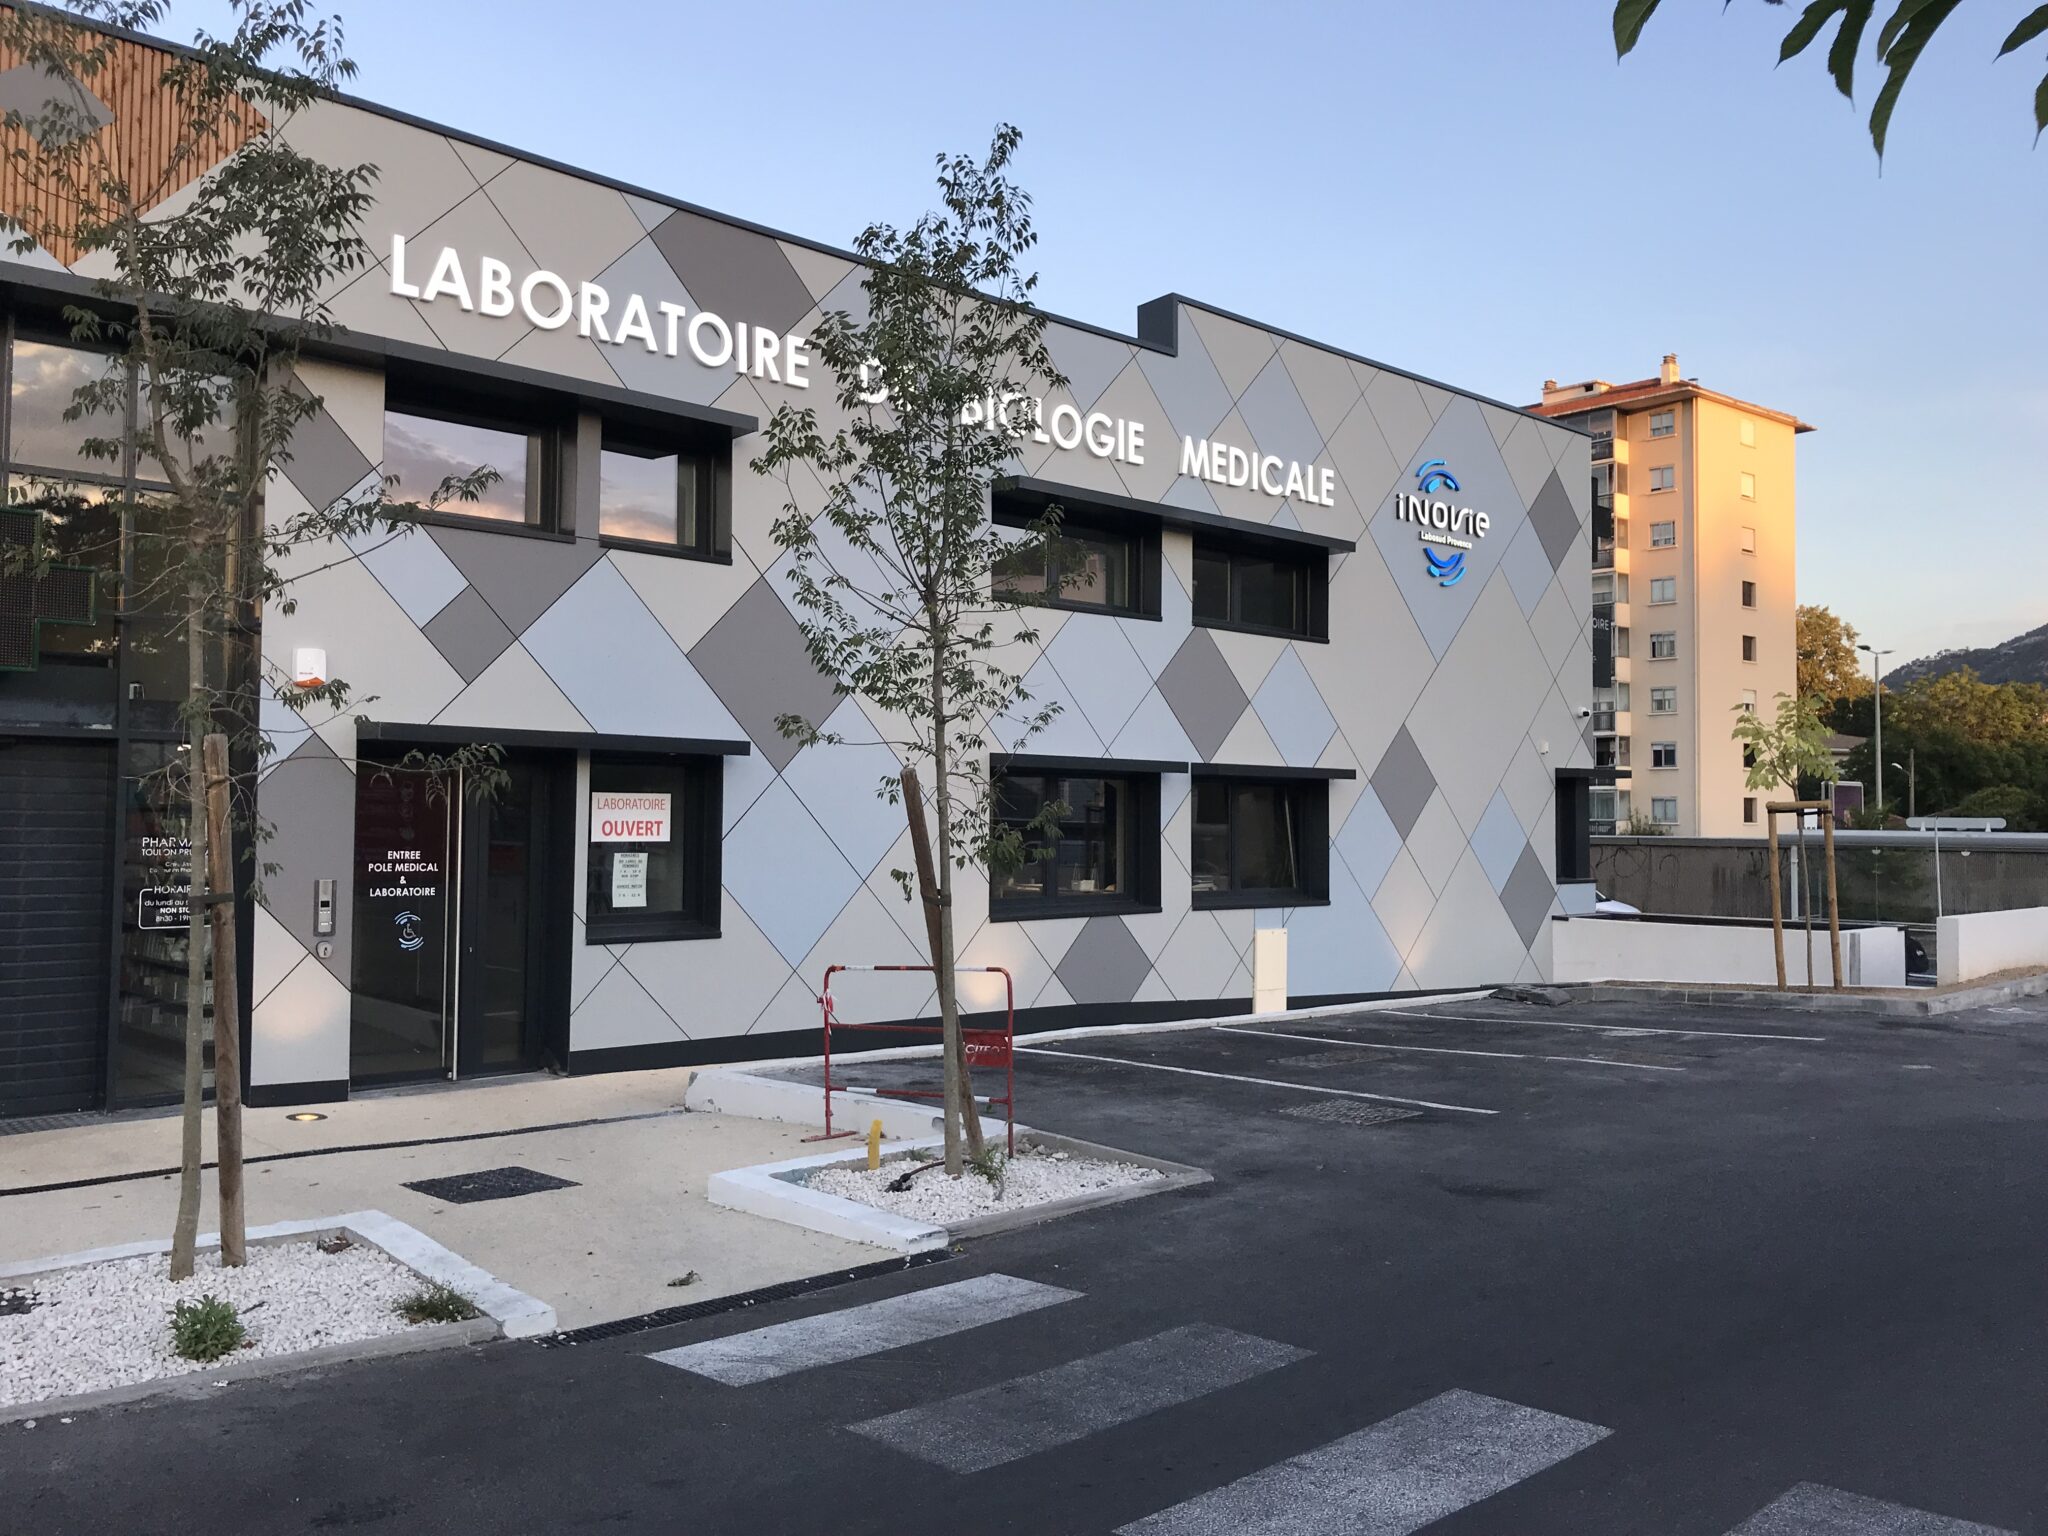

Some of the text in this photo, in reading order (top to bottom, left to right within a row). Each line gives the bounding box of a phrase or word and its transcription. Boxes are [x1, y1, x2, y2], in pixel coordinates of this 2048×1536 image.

[390, 233, 809, 388] LABORATOIRE
[1178, 434, 1335, 507] MEDICALE
[597, 798, 666, 811] LABORATOIRE
[601, 820, 663, 837] OUVERT
[387, 850, 421, 860] ENTREE
[368, 863, 439, 872] POLE MEDICAL
[399, 875, 407, 884] &
[369, 887, 436, 897] LABORATOIRE
